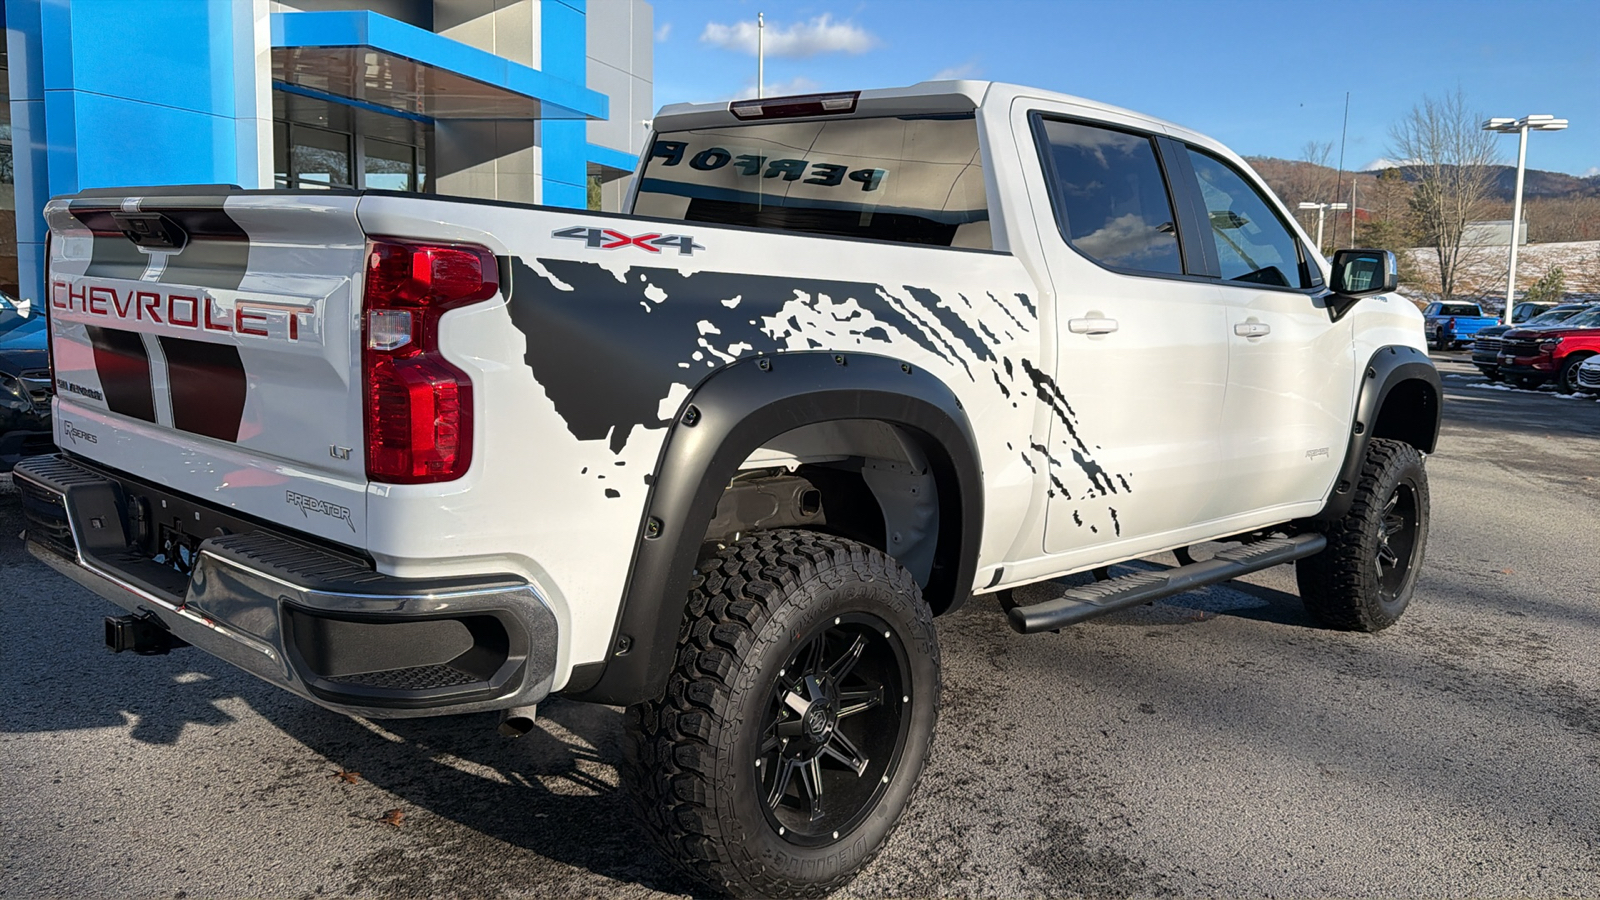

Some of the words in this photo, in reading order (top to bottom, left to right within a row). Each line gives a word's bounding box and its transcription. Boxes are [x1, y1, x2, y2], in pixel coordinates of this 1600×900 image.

[52, 281, 315, 341] CHEVROLET
[329, 444, 353, 461] LT
[286, 489, 356, 533] PREDATOR
